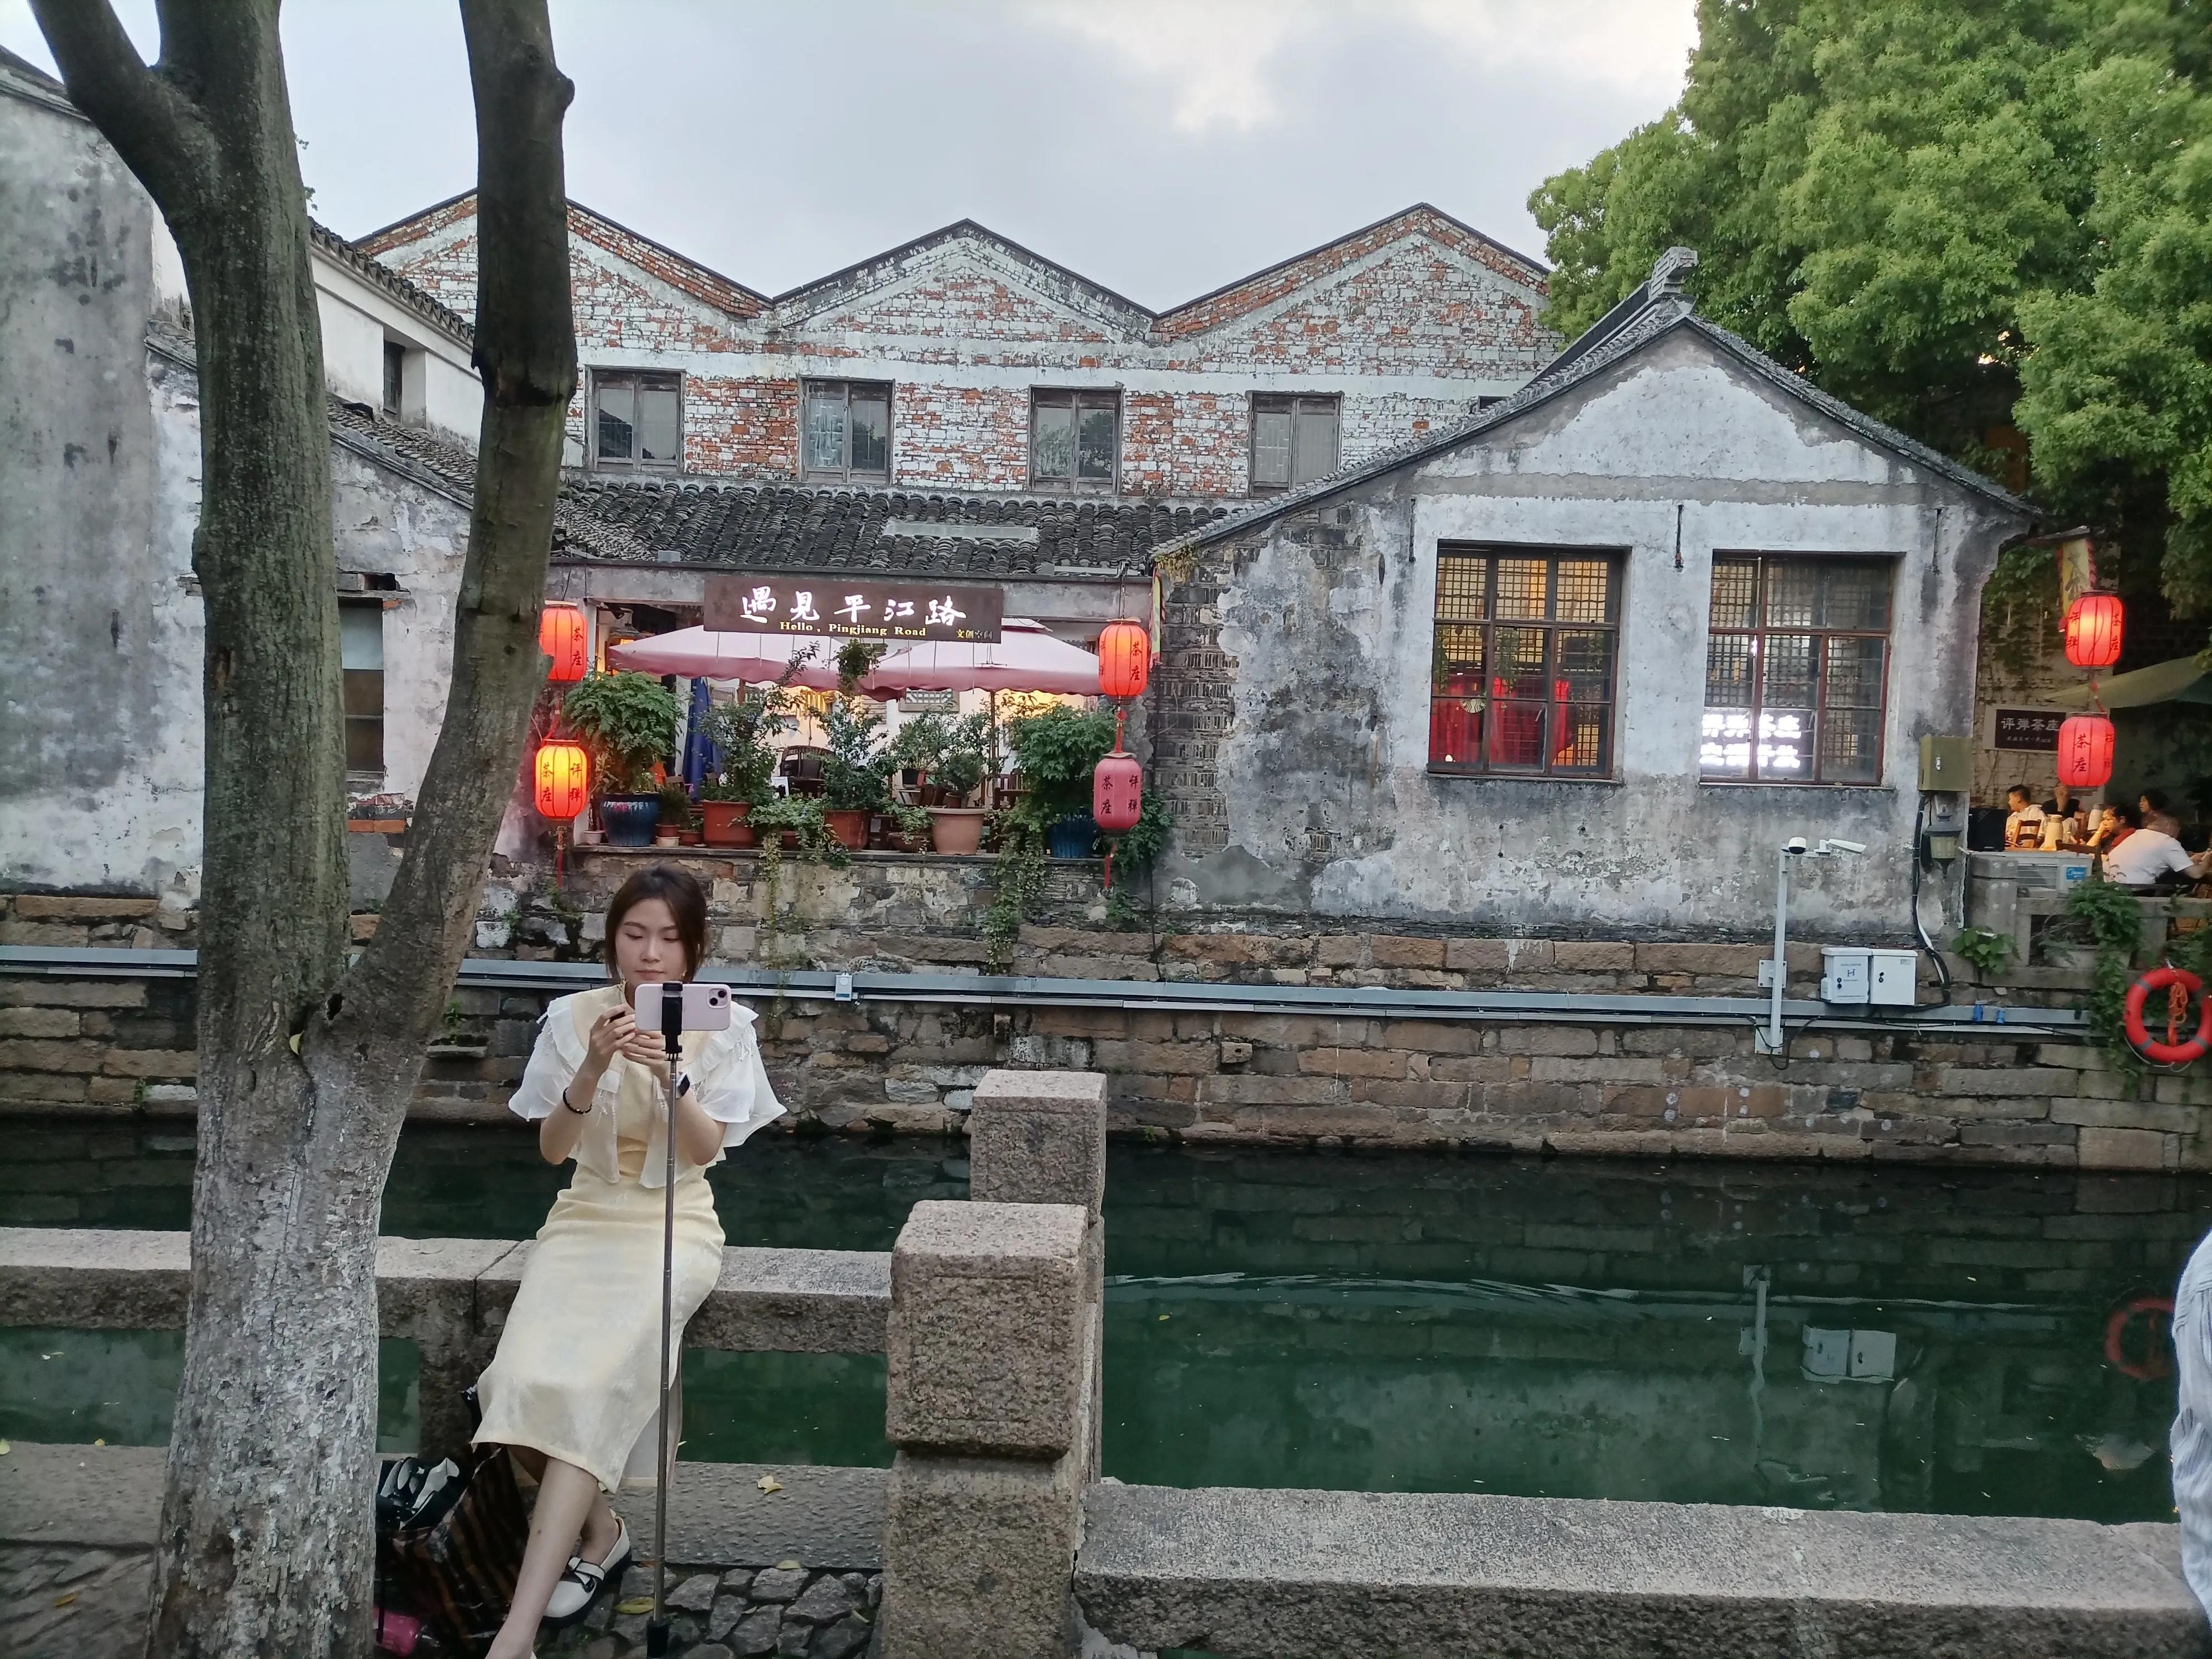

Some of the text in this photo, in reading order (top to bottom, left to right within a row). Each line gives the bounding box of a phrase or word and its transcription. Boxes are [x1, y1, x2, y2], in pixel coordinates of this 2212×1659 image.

[572, 626, 583, 666] 茶座
[828, 623, 888, 636] Pingjiang
[894, 627, 926, 636] Road
[1130, 640, 1142, 681] 茶座
[2001, 718, 2060, 731] 评弹茶座
[2073, 733, 2091, 773] 茶座
[541, 761, 554, 803] 茶座
[1100, 775, 1113, 815] 茶座
